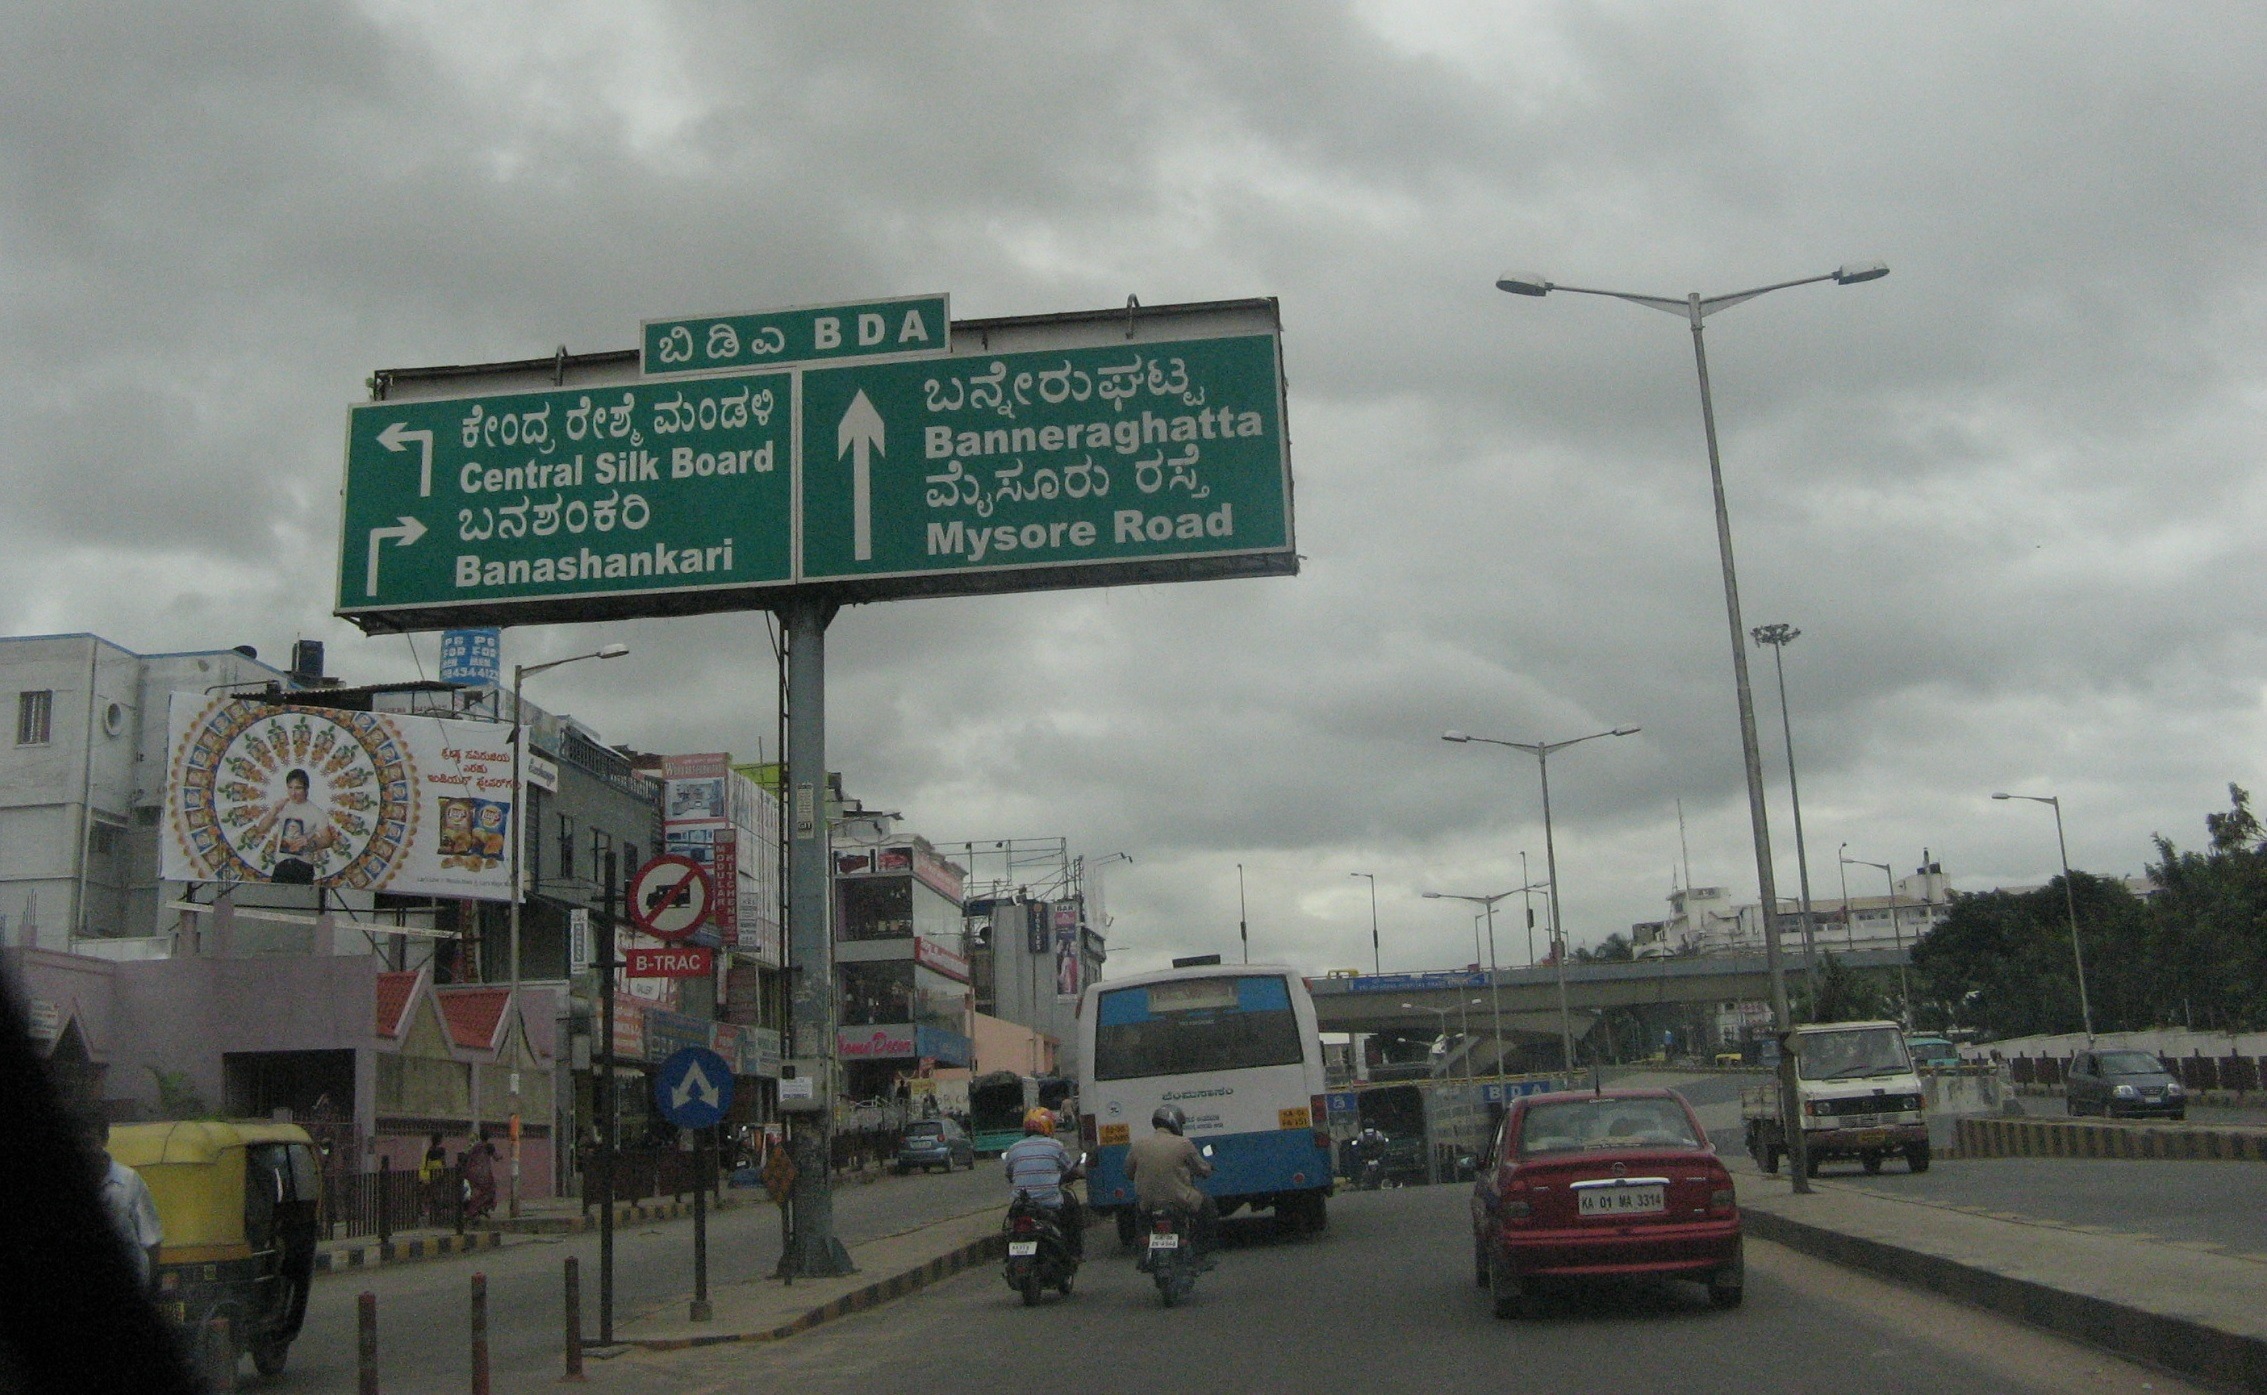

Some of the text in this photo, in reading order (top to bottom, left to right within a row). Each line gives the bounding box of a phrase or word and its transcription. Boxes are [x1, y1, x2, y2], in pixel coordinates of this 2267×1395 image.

[923, 354, 1205, 419] ಬನ್ನೇರುಘಟ್ಟ
[460, 384, 775, 455] ಕೇಂದ್ರ ರೇಶ್ಮೆ ಮಂಡಳಿ
[923, 406, 1263, 459] Banneraghatta
[458, 440, 774, 494] Central Silk Board
[925, 443, 1211, 518] ಮೈಸೂರು ರಸ್ತೆ
[458, 489, 652, 542] ಬನಶಂಕರಿ
[926, 503, 1234, 562] Mysore Road
[454, 537, 734, 589] Banashankari
[635, 955, 702, 972] B-TRAC
[1581, 1193, 1661, 1210] KA 01 MA 3314
